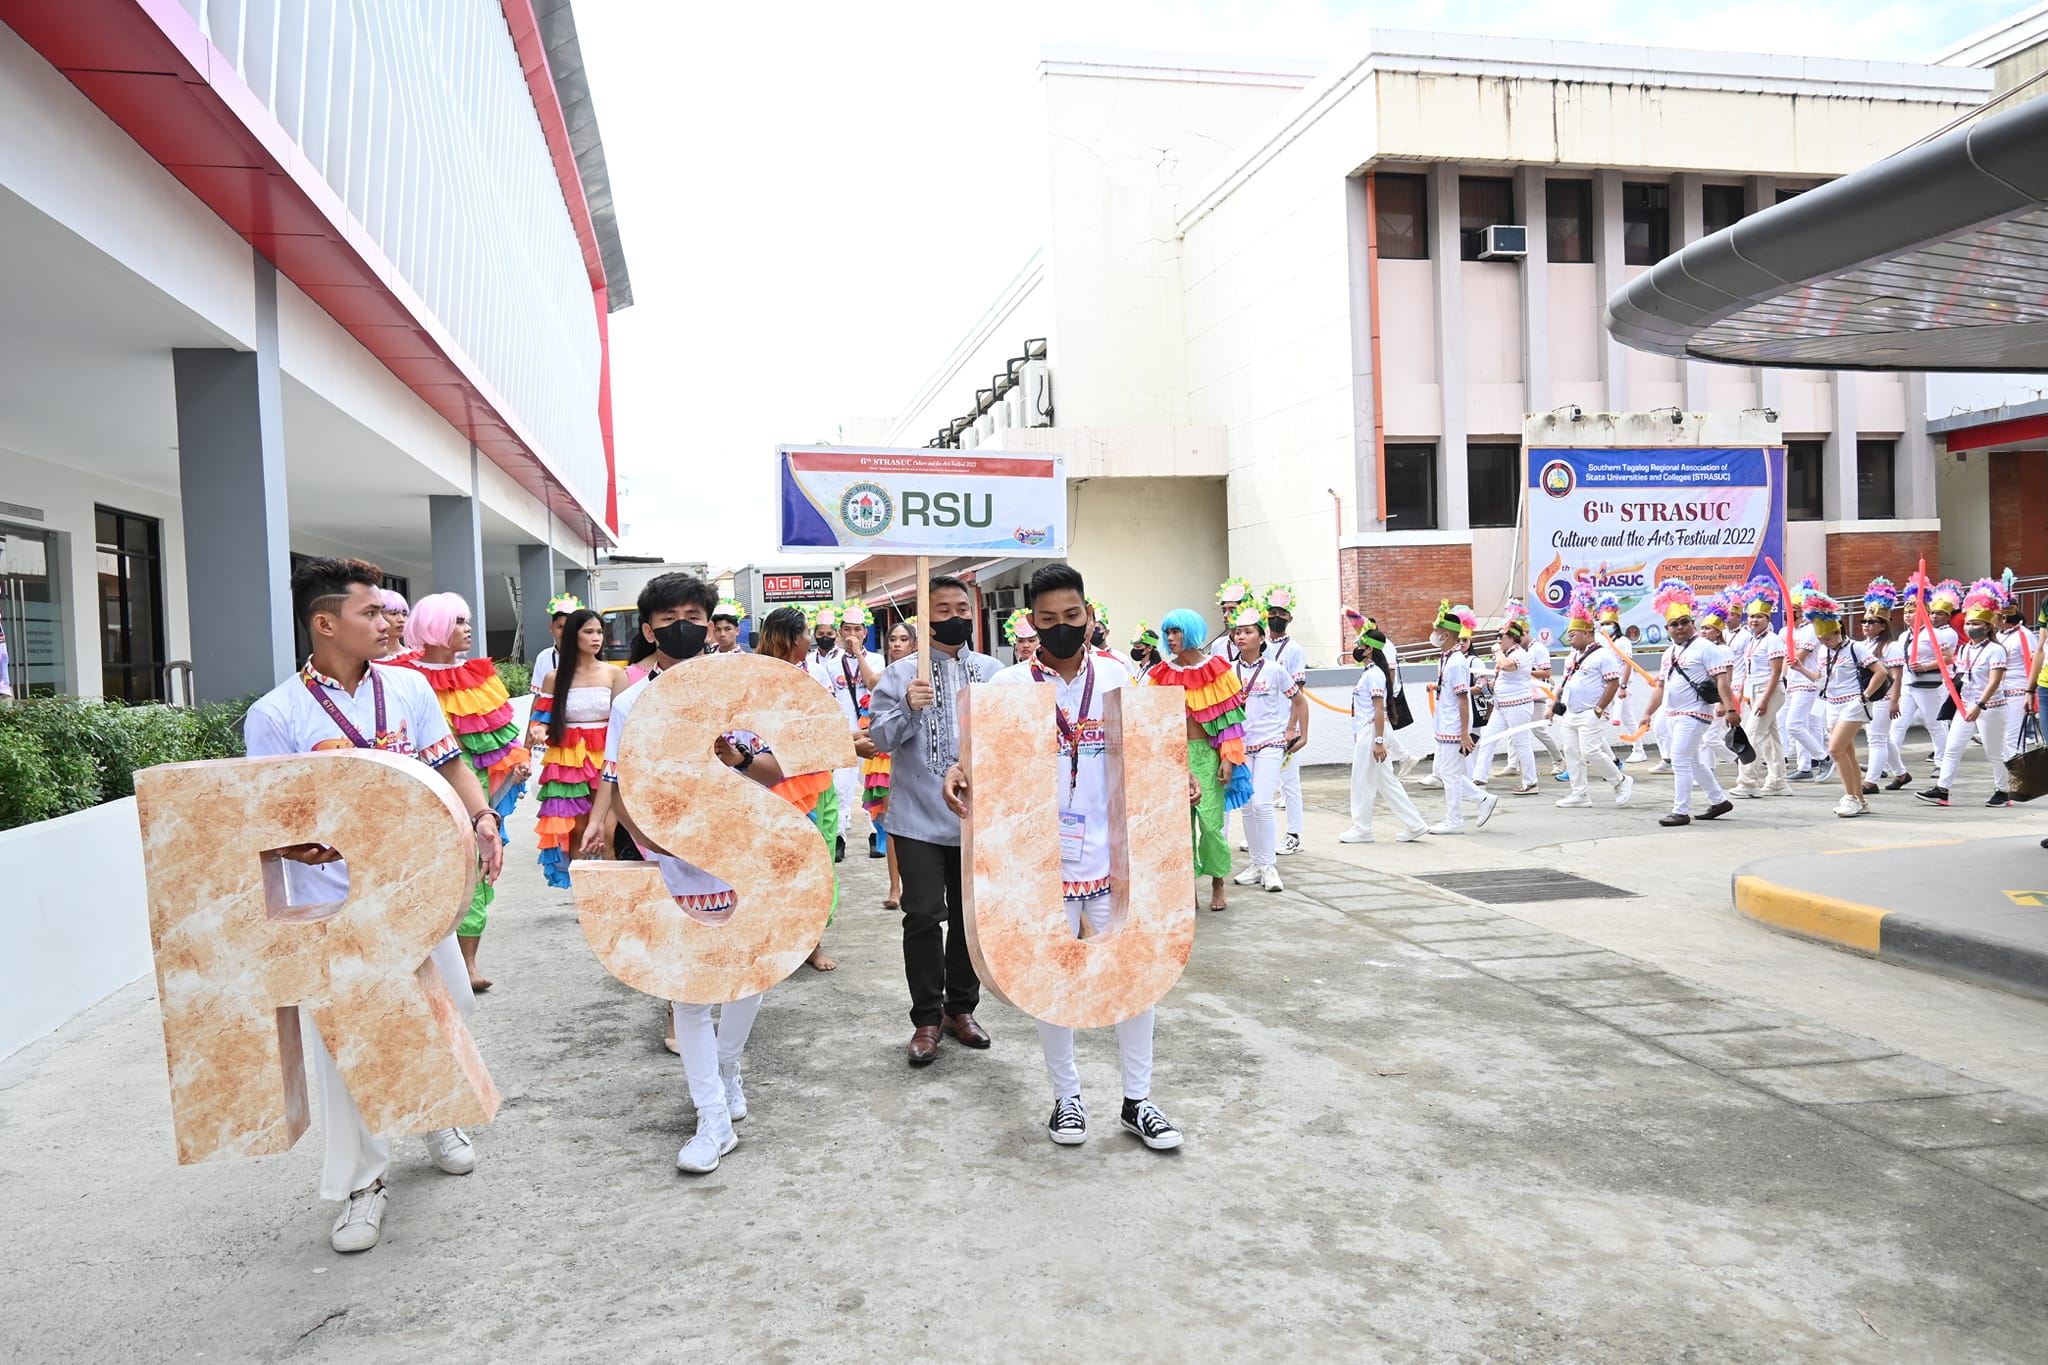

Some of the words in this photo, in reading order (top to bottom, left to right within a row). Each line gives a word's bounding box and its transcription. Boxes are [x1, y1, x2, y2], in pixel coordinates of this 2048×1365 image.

[873, 458, 913, 467] STRASUC
[1588, 463, 1621, 471] Southern
[1622, 463, 1650, 473] Tagalog
[1650, 463, 1680, 472] Regional
[1681, 463, 1720, 471] Association
[1721, 463, 1728, 471] of
[1586, 473, 1606, 481] State
[1607, 473, 1648, 481] Universities
[1663, 473, 1691, 482] Colleges
[1692, 473, 1731, 482] (STRASUC)
[902, 491, 993, 528] RSU
[1583, 500, 1614, 522] 6th
[1620, 502, 1731, 523] STRASUC
[1551, 530, 1599, 548] Culture
[1600, 530, 1626, 547] and
[1627, 530, 1645, 546] the
[1647, 529, 1675, 546] Arts
[1675, 528, 1721, 546] Festival
[1722, 528, 1756, 545] 2022
[1692, 574, 1718, 582] Strategic
[323, 699, 337, 713] 6TH
[333, 710, 362, 742] STRASUC
